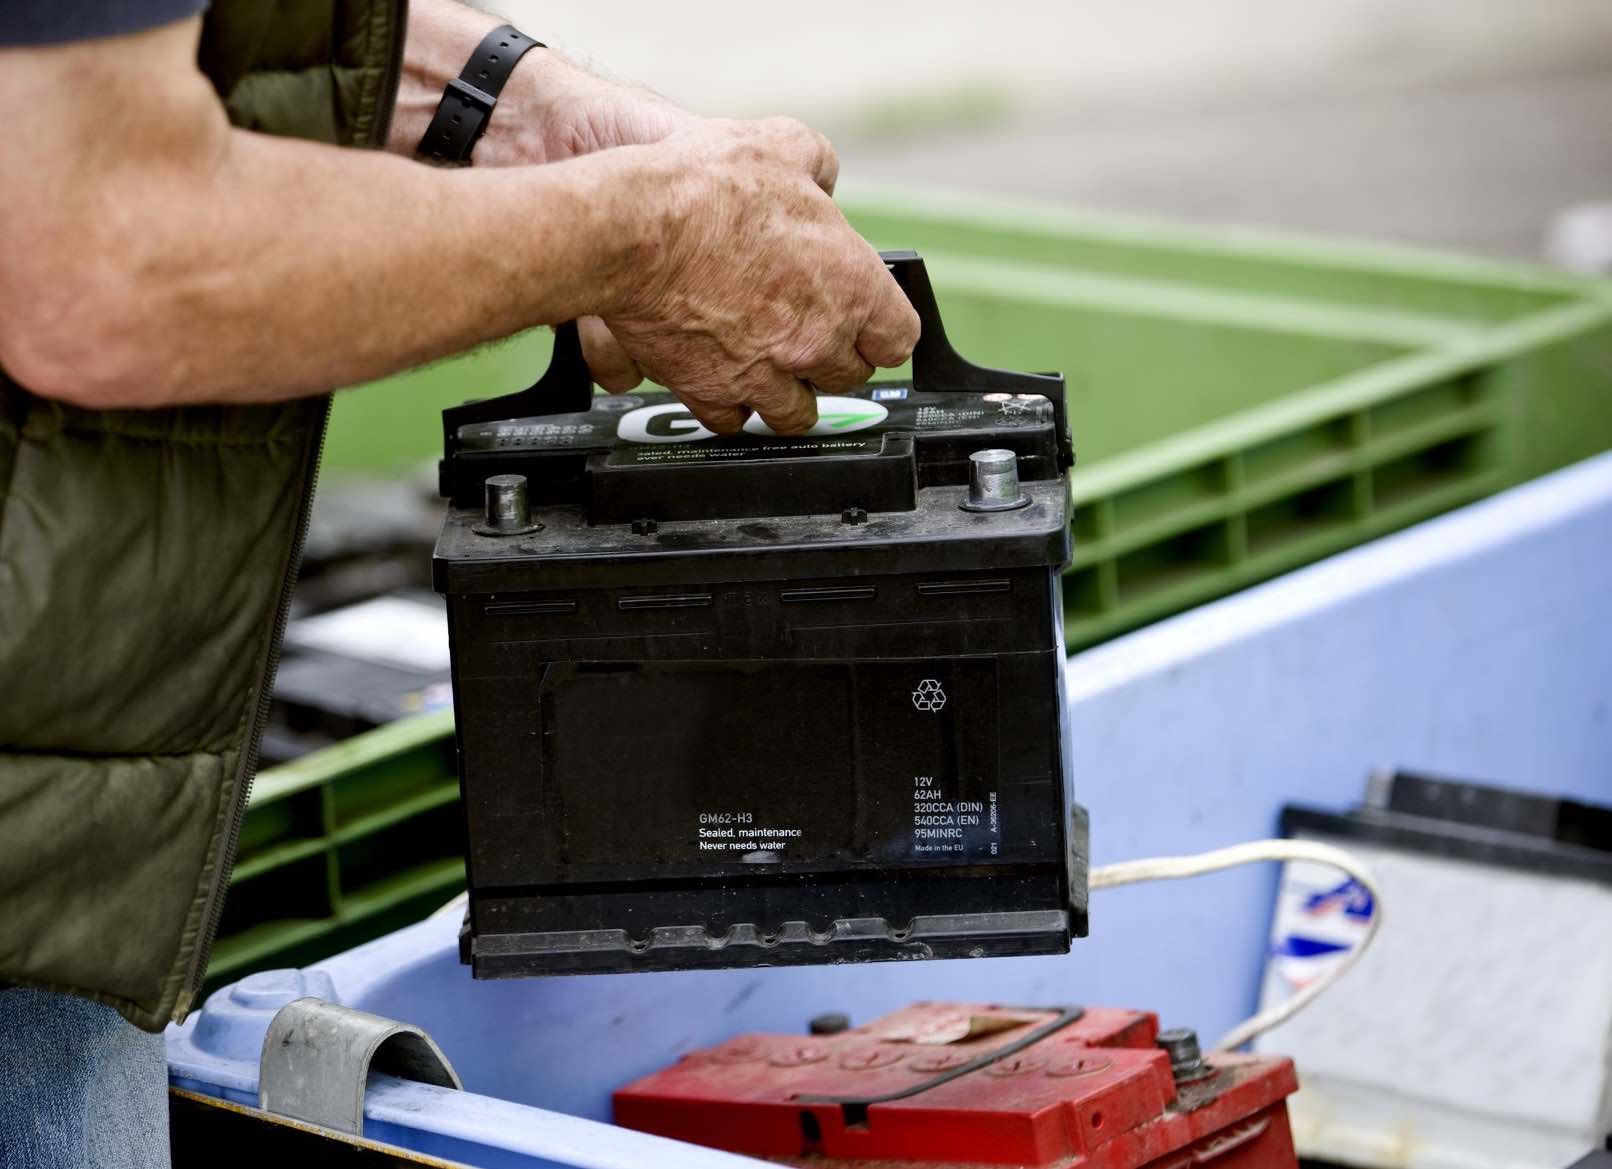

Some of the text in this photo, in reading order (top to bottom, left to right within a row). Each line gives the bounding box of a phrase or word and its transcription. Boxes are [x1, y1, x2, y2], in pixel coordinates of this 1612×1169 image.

[822, 441, 867, 449] battery
[914, 776, 933, 787] 12V
[914, 789, 942, 800] 62AH
[914, 802, 983, 813] 320CCA (DIN)
[699, 812, 753, 824] GM62-H3
[914, 815, 979, 826] 540CCA (EN)
[738, 827, 802, 838] maintenance
[914, 828, 963, 839] 95MINRC
[699, 840, 786, 851] Never needs water
